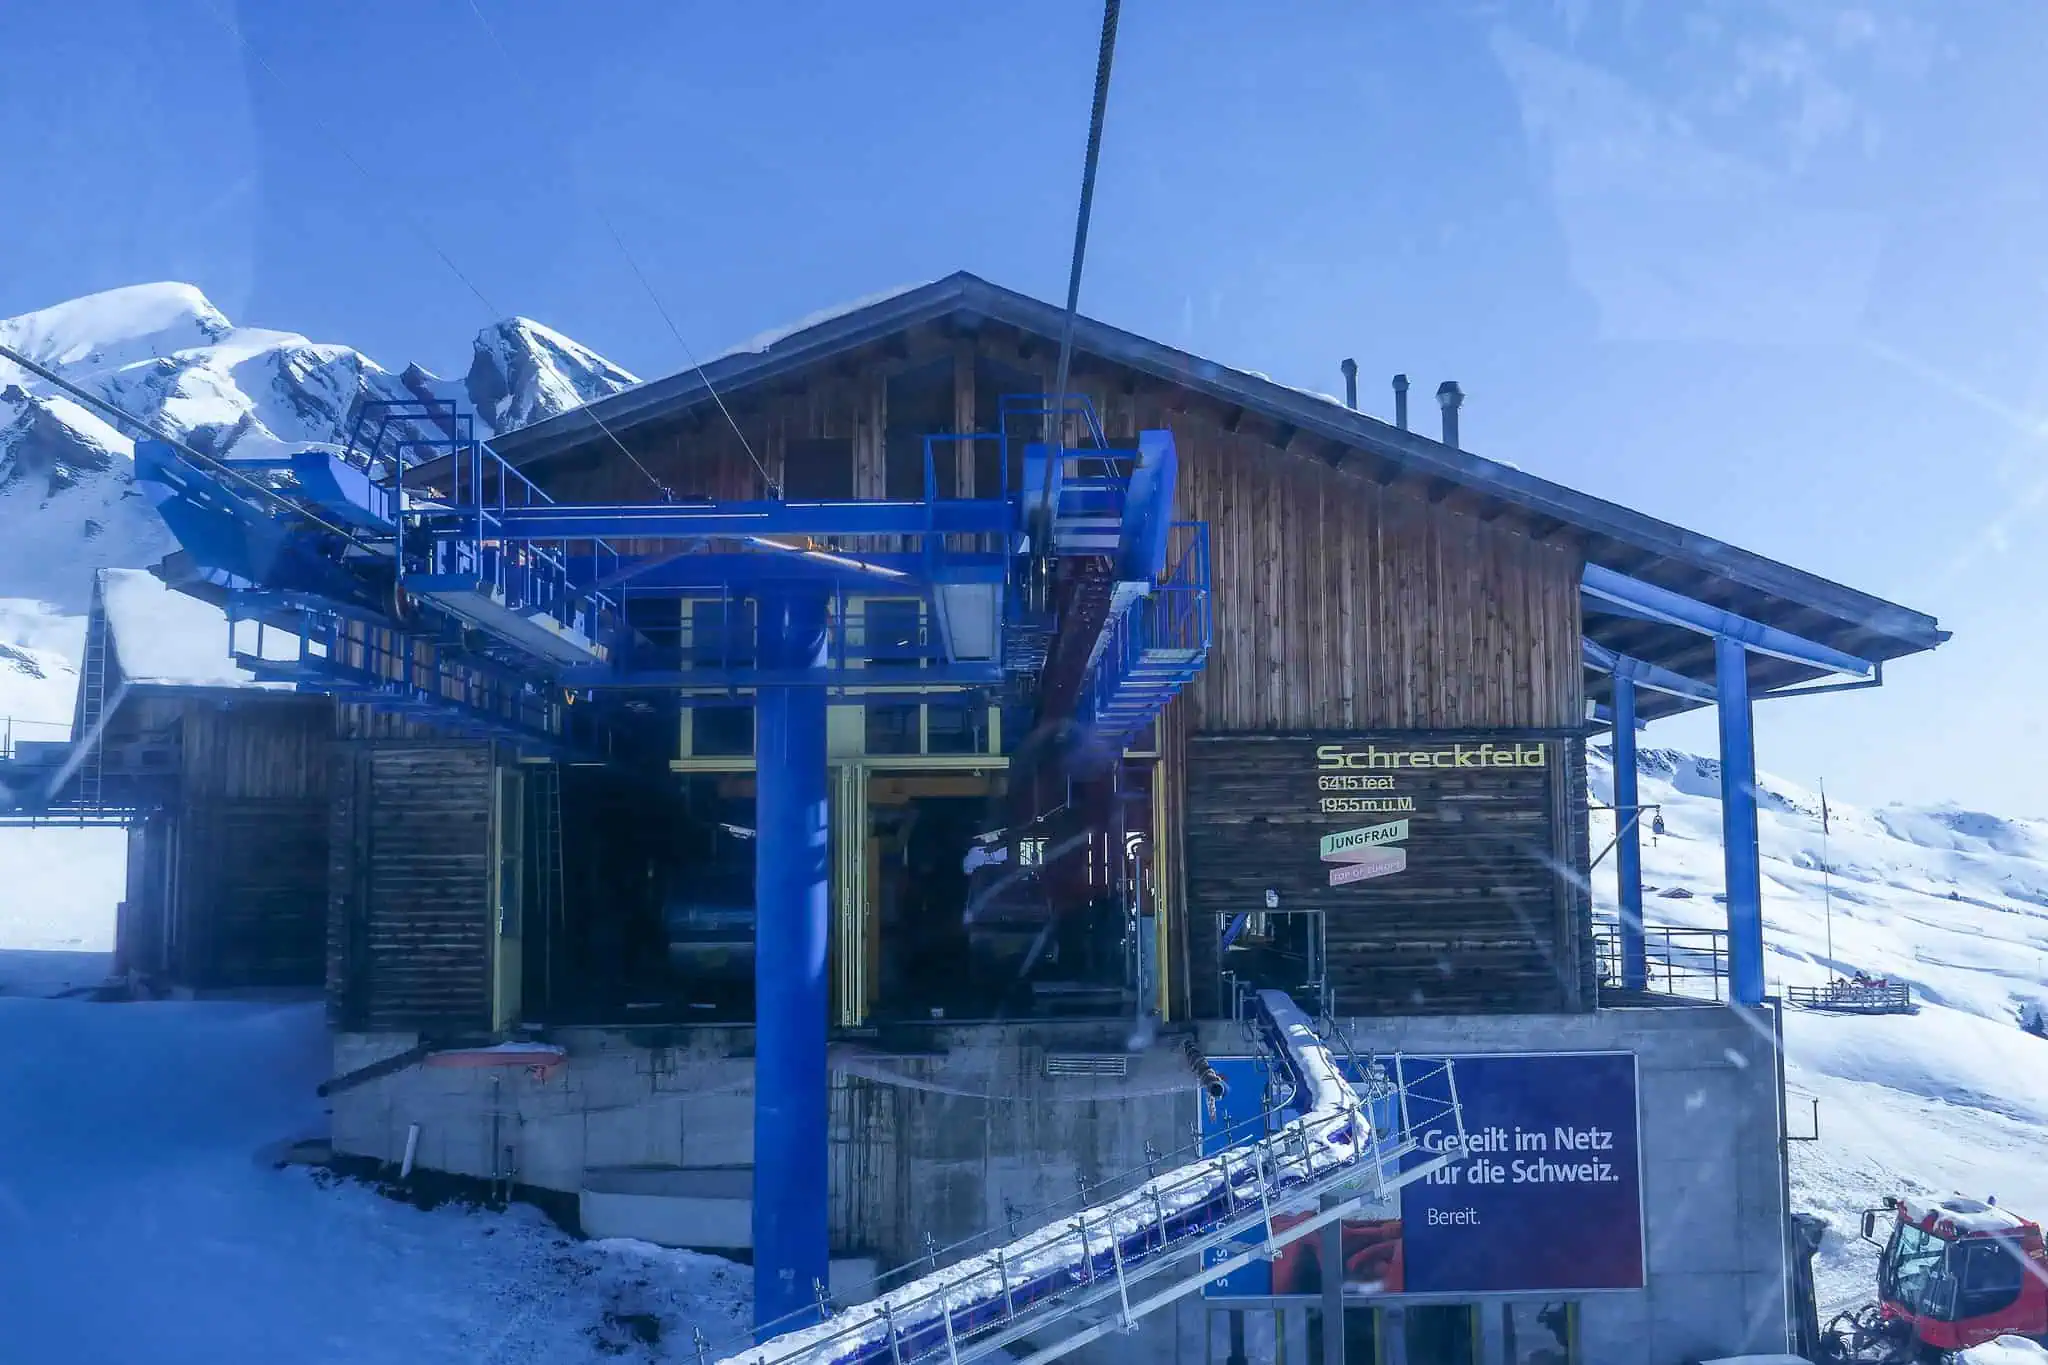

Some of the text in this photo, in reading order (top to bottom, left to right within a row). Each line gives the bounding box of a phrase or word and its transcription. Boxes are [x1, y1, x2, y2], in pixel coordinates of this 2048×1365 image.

[1316, 743, 1545, 769] Schreckfeld
[1318, 775, 1395, 791] 6415 feet
[1330, 826, 1398, 852] JUNGFRAU
[1514, 1126, 1547, 1152] im
[1554, 1126, 1613, 1150] Netz
[1467, 1158, 1505, 1184] die
[1511, 1156, 1619, 1184] Schweiz.
[1427, 1207, 1481, 1225] Bereit.
